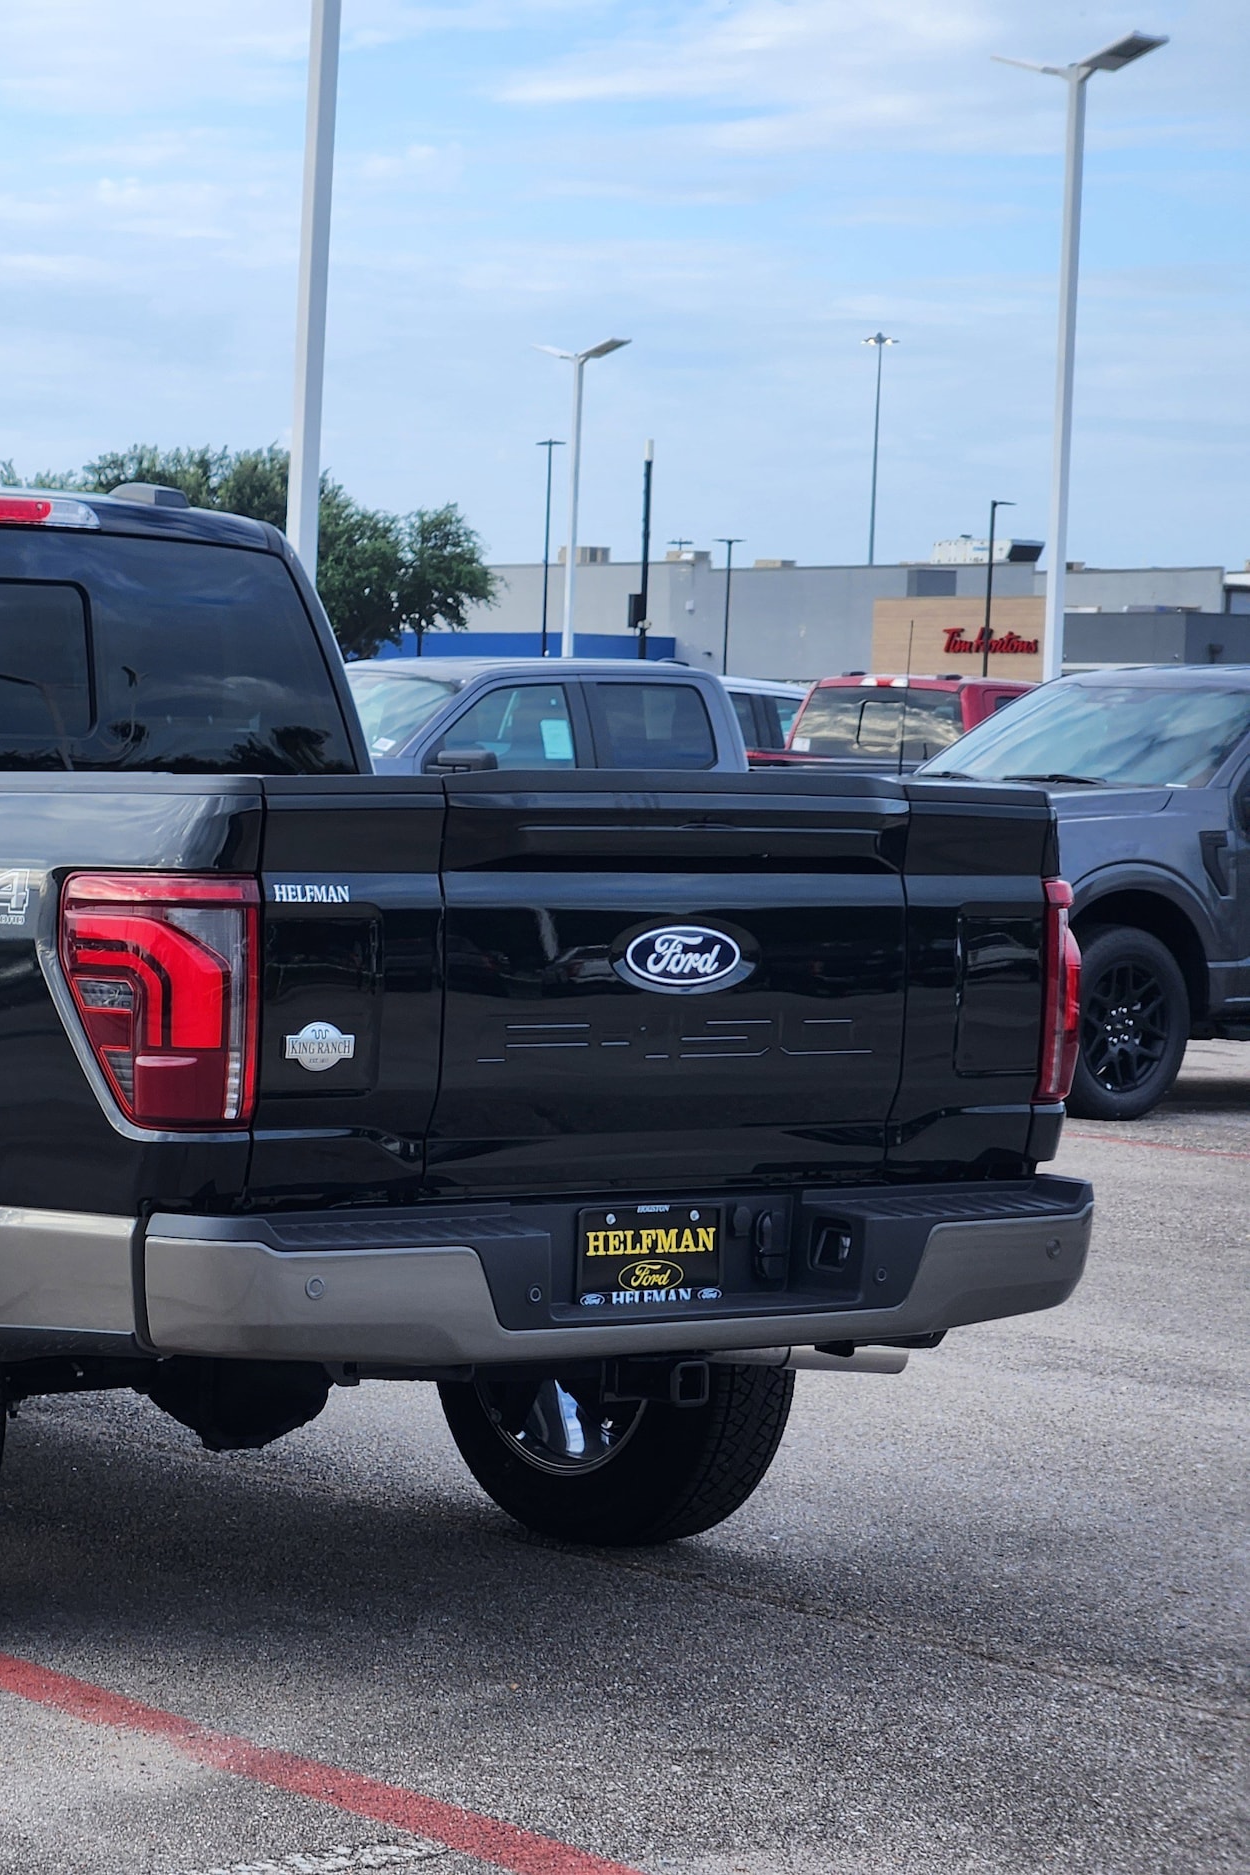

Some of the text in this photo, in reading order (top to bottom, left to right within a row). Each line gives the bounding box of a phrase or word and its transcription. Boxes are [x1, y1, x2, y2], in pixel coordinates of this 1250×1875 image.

[942, 628, 973, 653] Tim
[273, 884, 350, 903] HELFMAN
[646, 934, 721, 974] Ford
[291, 1040, 350, 1054] KING RANCH
[636, 1204, 671, 1213] HOUSTON
[586, 1227, 716, 1256] HELFMAN
[631, 1263, 671, 1287] Ford
[612, 1288, 692, 1305] HELFMAN
